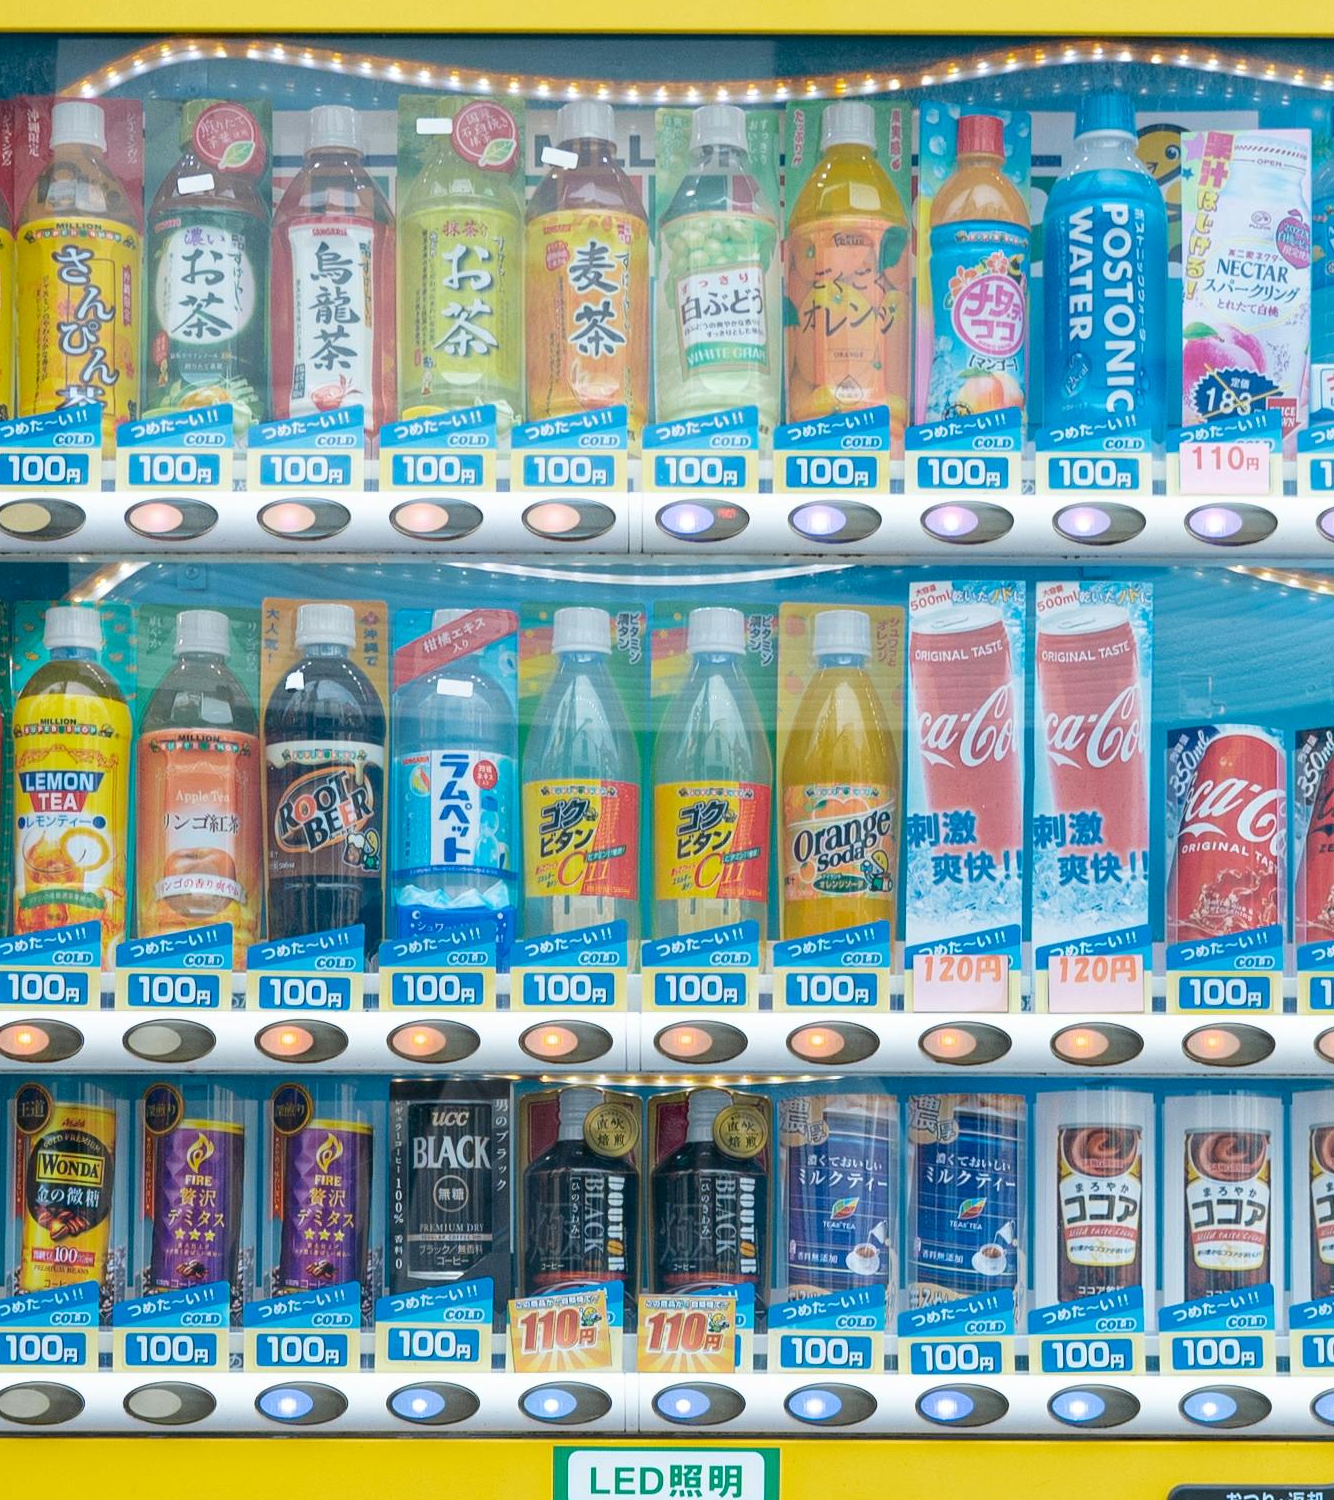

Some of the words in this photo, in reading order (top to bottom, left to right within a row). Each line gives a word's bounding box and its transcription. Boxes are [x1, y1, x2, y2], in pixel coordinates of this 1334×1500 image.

[56, 222, 103, 231] MILLION
[1066, 207, 1094, 341] WATER
[1216, 258, 1289, 285] NECTAR
[171, 247, 233, 338] お茶
[433, 243, 499, 358] お茶
[567, 240, 627, 359] 麦茶
[1203, 278, 1301, 304] スパークリング
[308, 240, 361, 373] 烏龍茶
[802, 299, 897, 338] オレンジ
[1100, 202, 1139, 414] POSTONIC
[1217, 299, 1280, 319] とれたて白桃
[709, 435, 749, 448] COLD
[138, 454, 213, 485] 100円
[401, 454, 477, 485] 100円
[663, 456, 739, 486] 100円
[927, 457, 1002, 488] 100円
[1192, 445, 1260, 472] 110円
[910, 589, 952, 612] 500ml
[423, 617, 486, 653] 柑橘エキス
[915, 649, 969, 664] ORIGINAL
[971, 639, 1004, 659] TASTE
[25, 772, 94, 791] LEMON
[38, 792, 78, 811] TEA
[176, 790, 208, 804] Apple
[279, 771, 353, 833] ROOT
[438, 753, 473, 864] ラムペット
[26, 814, 92, 828] レモンティー
[305, 784, 375, 852] BEER
[539, 797, 590, 836] ゴク
[907, 811, 975, 846] 刺激
[540, 828, 597, 858] ビタン
[794, 810, 891, 863] Orange
[817, 840, 865, 872] soda
[53, 951, 93, 964] COLD
[579, 952, 619, 965] COLD
[924, 957, 1002, 982] 120円
[1059, 957, 1137, 982] 120円
[7, 972, 81, 1003] 100円
[269, 978, 343, 1009] 100円
[533, 973, 608, 1004] 100円
[795, 974, 870, 1004] 100円
[412, 1134, 492, 1170] BLACK
[495, 1098, 508, 1193] 男のブラック
[41, 1155, 100, 1179] WONDA
[808, 1155, 882, 1172] 濃くておいしい
[185, 1174, 213, 1187] FIRE
[437, 1187, 465, 1202] 無糖
[799, 1170, 888, 1189] ミルクティー
[1075, 1182, 1129, 1193] まろやか
[168, 1209, 226, 1228] デミタス
[584, 1178, 604, 1255] BLACK
[715, 1178, 736, 1255] BLACK
[1065, 1195, 1137, 1224] ココア
[1192, 1199, 1266, 1228] ココア
[419, 1222, 464, 1232] PREMIUM
[466, 1222, 484, 1233] DRY
[444, 1308, 484, 1321] COLD
[520, 1308, 600, 1354] 110円
[648, 1311, 724, 1354] 110円
[4, 1334, 79, 1363] 100円
[266, 1335, 340, 1365] 100円
[790, 1336, 864, 1367] 100円
[1051, 1340, 1126, 1369] 100円
[589, 1462, 743, 1499] LED照明
